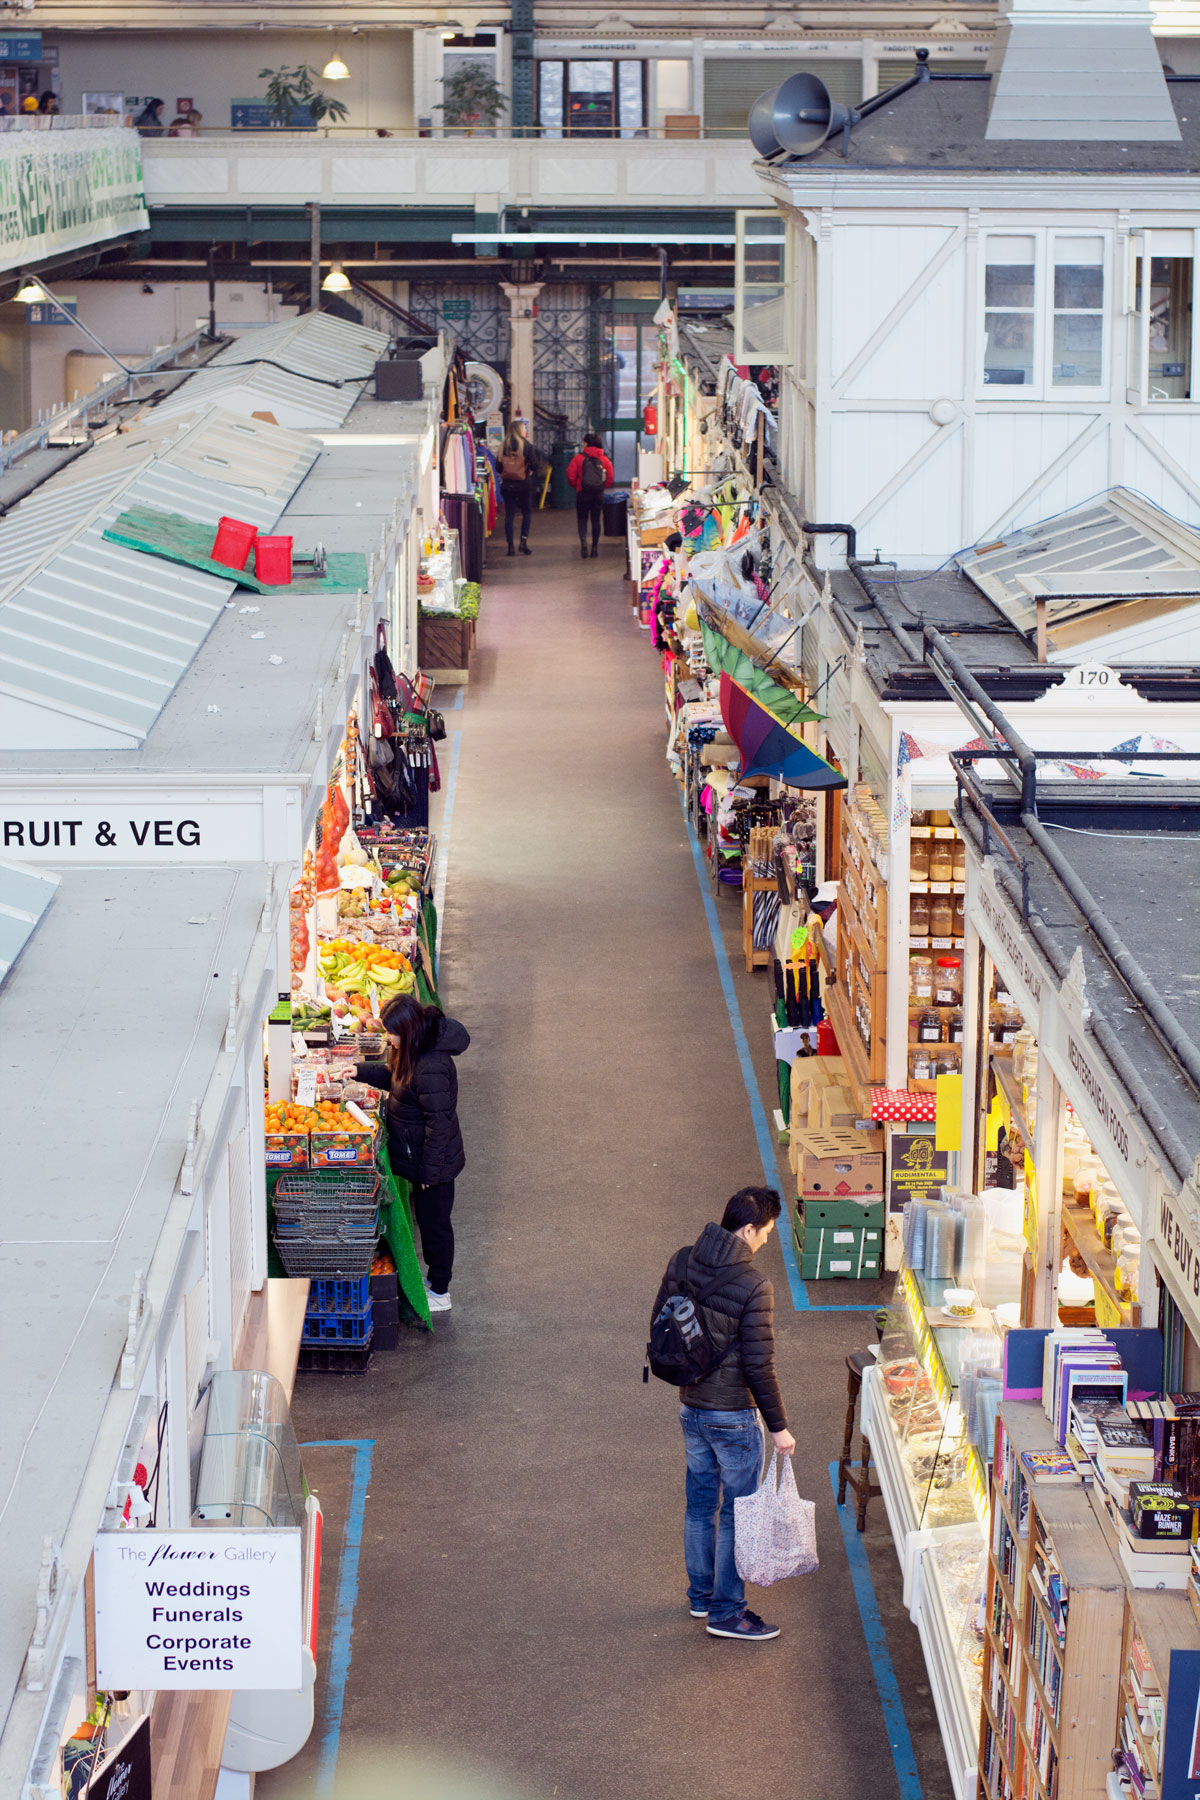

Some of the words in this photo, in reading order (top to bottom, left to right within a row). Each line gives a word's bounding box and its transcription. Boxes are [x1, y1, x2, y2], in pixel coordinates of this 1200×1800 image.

[1079, 670, 1109, 685] 170
[3, 821, 83, 846] RUIT
[95, 820, 118, 847] &
[129, 820, 202, 847] VEG
[1067, 1034, 1109, 1128] MEDITERRANEAN
[1109, 1106, 1129, 1162] FOODS
[1160, 1197, 1173, 1249] WE
[1174, 1222, 1193, 1281] BUY
[1168, 1436, 1176, 1462] BANKS
[1157, 1521, 1182, 1529] RUNNER
[117, 1546, 147, 1562] The
[147, 1544, 219, 1567] flower
[223, 1546, 277, 1565] Gallery
[145, 1581, 251, 1601] Weddings
[151, 1606, 243, 1623] Funerals
[146, 1634, 252, 1653] Corporate
[163, 1655, 234, 1671] Events
[106, 1762, 132, 1800] flower
